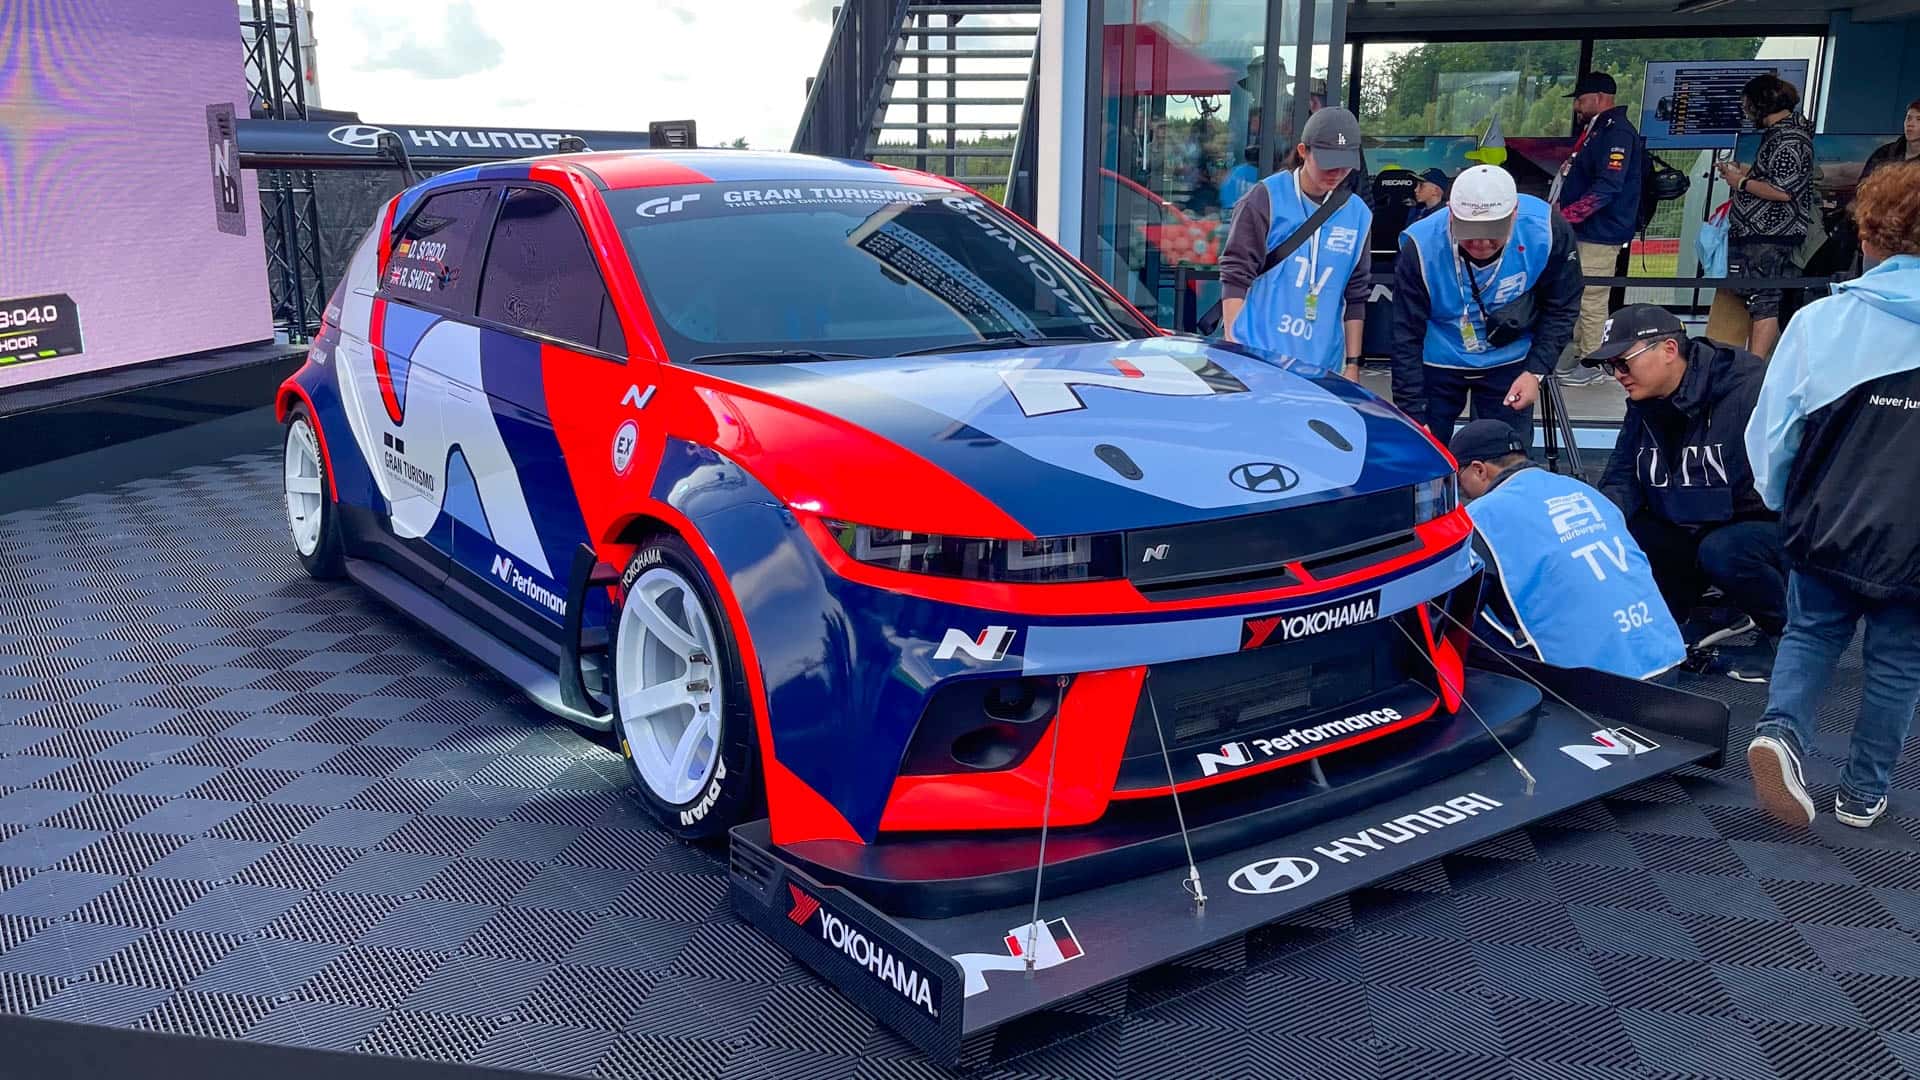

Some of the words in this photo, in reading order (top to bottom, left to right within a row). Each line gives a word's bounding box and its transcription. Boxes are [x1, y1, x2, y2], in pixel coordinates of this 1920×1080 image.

[408, 129, 572, 150] HYUNDA
[723, 189, 803, 202] GRAN
[809, 188, 923, 202] TURISMO
[408, 240, 417, 259] D.
[417, 241, 446, 261] SORDO
[399, 267, 408, 287] R.
[408, 269, 434, 292] SHUTE
[1277, 314, 1313, 340] 300
[1869, 394, 1904, 407] Never
[1903, 397, 1920, 410] ju
[617, 437, 633, 455] EX
[385, 451, 403, 475] GRAN
[403, 460, 435, 492] TURISMO
[622, 548, 663, 588] YOKOHAMA
[1570, 535, 1630, 581] TV
[1281, 598, 1377, 641] YOKOHAMA
[1613, 601, 1654, 633] 362
[1252, 707, 1403, 757] Performance
[680, 755, 727, 826] ADVAN
[1313, 792, 1504, 864] HYUNDAI
[819, 907, 938, 1017] YOKOHAMA
